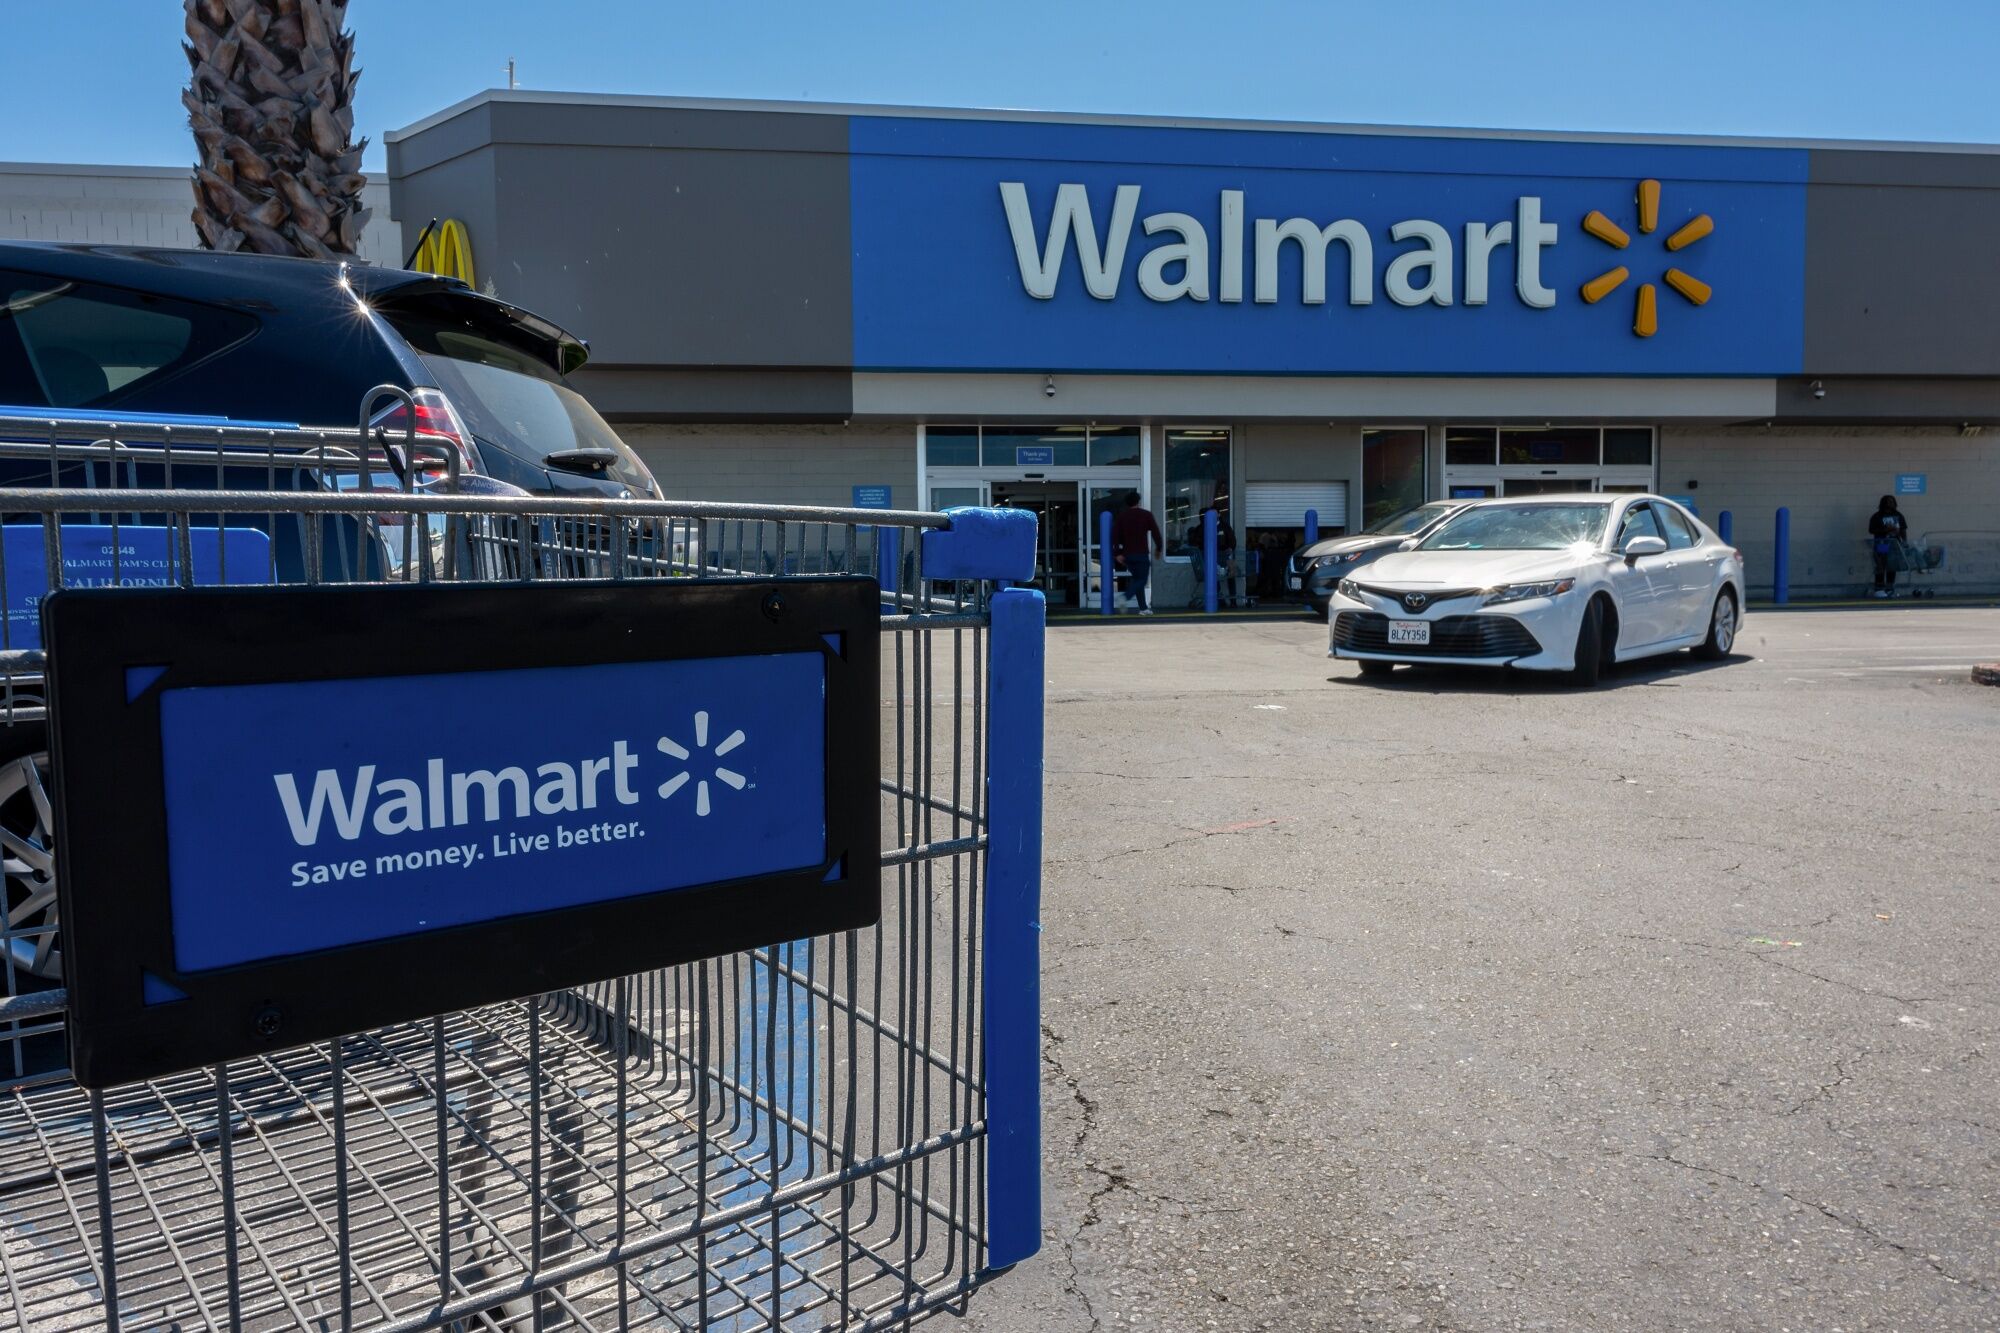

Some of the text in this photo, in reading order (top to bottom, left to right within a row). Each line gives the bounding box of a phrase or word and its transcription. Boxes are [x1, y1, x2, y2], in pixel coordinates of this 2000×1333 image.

[1000, 181, 1558, 308] Walmart
[62, 559, 113, 568] ALMART
[1391, 629, 1427, 640] 8LZY358
[273, 739, 639, 847] Walmart
[291, 820, 646, 887] Save money. Live better.
